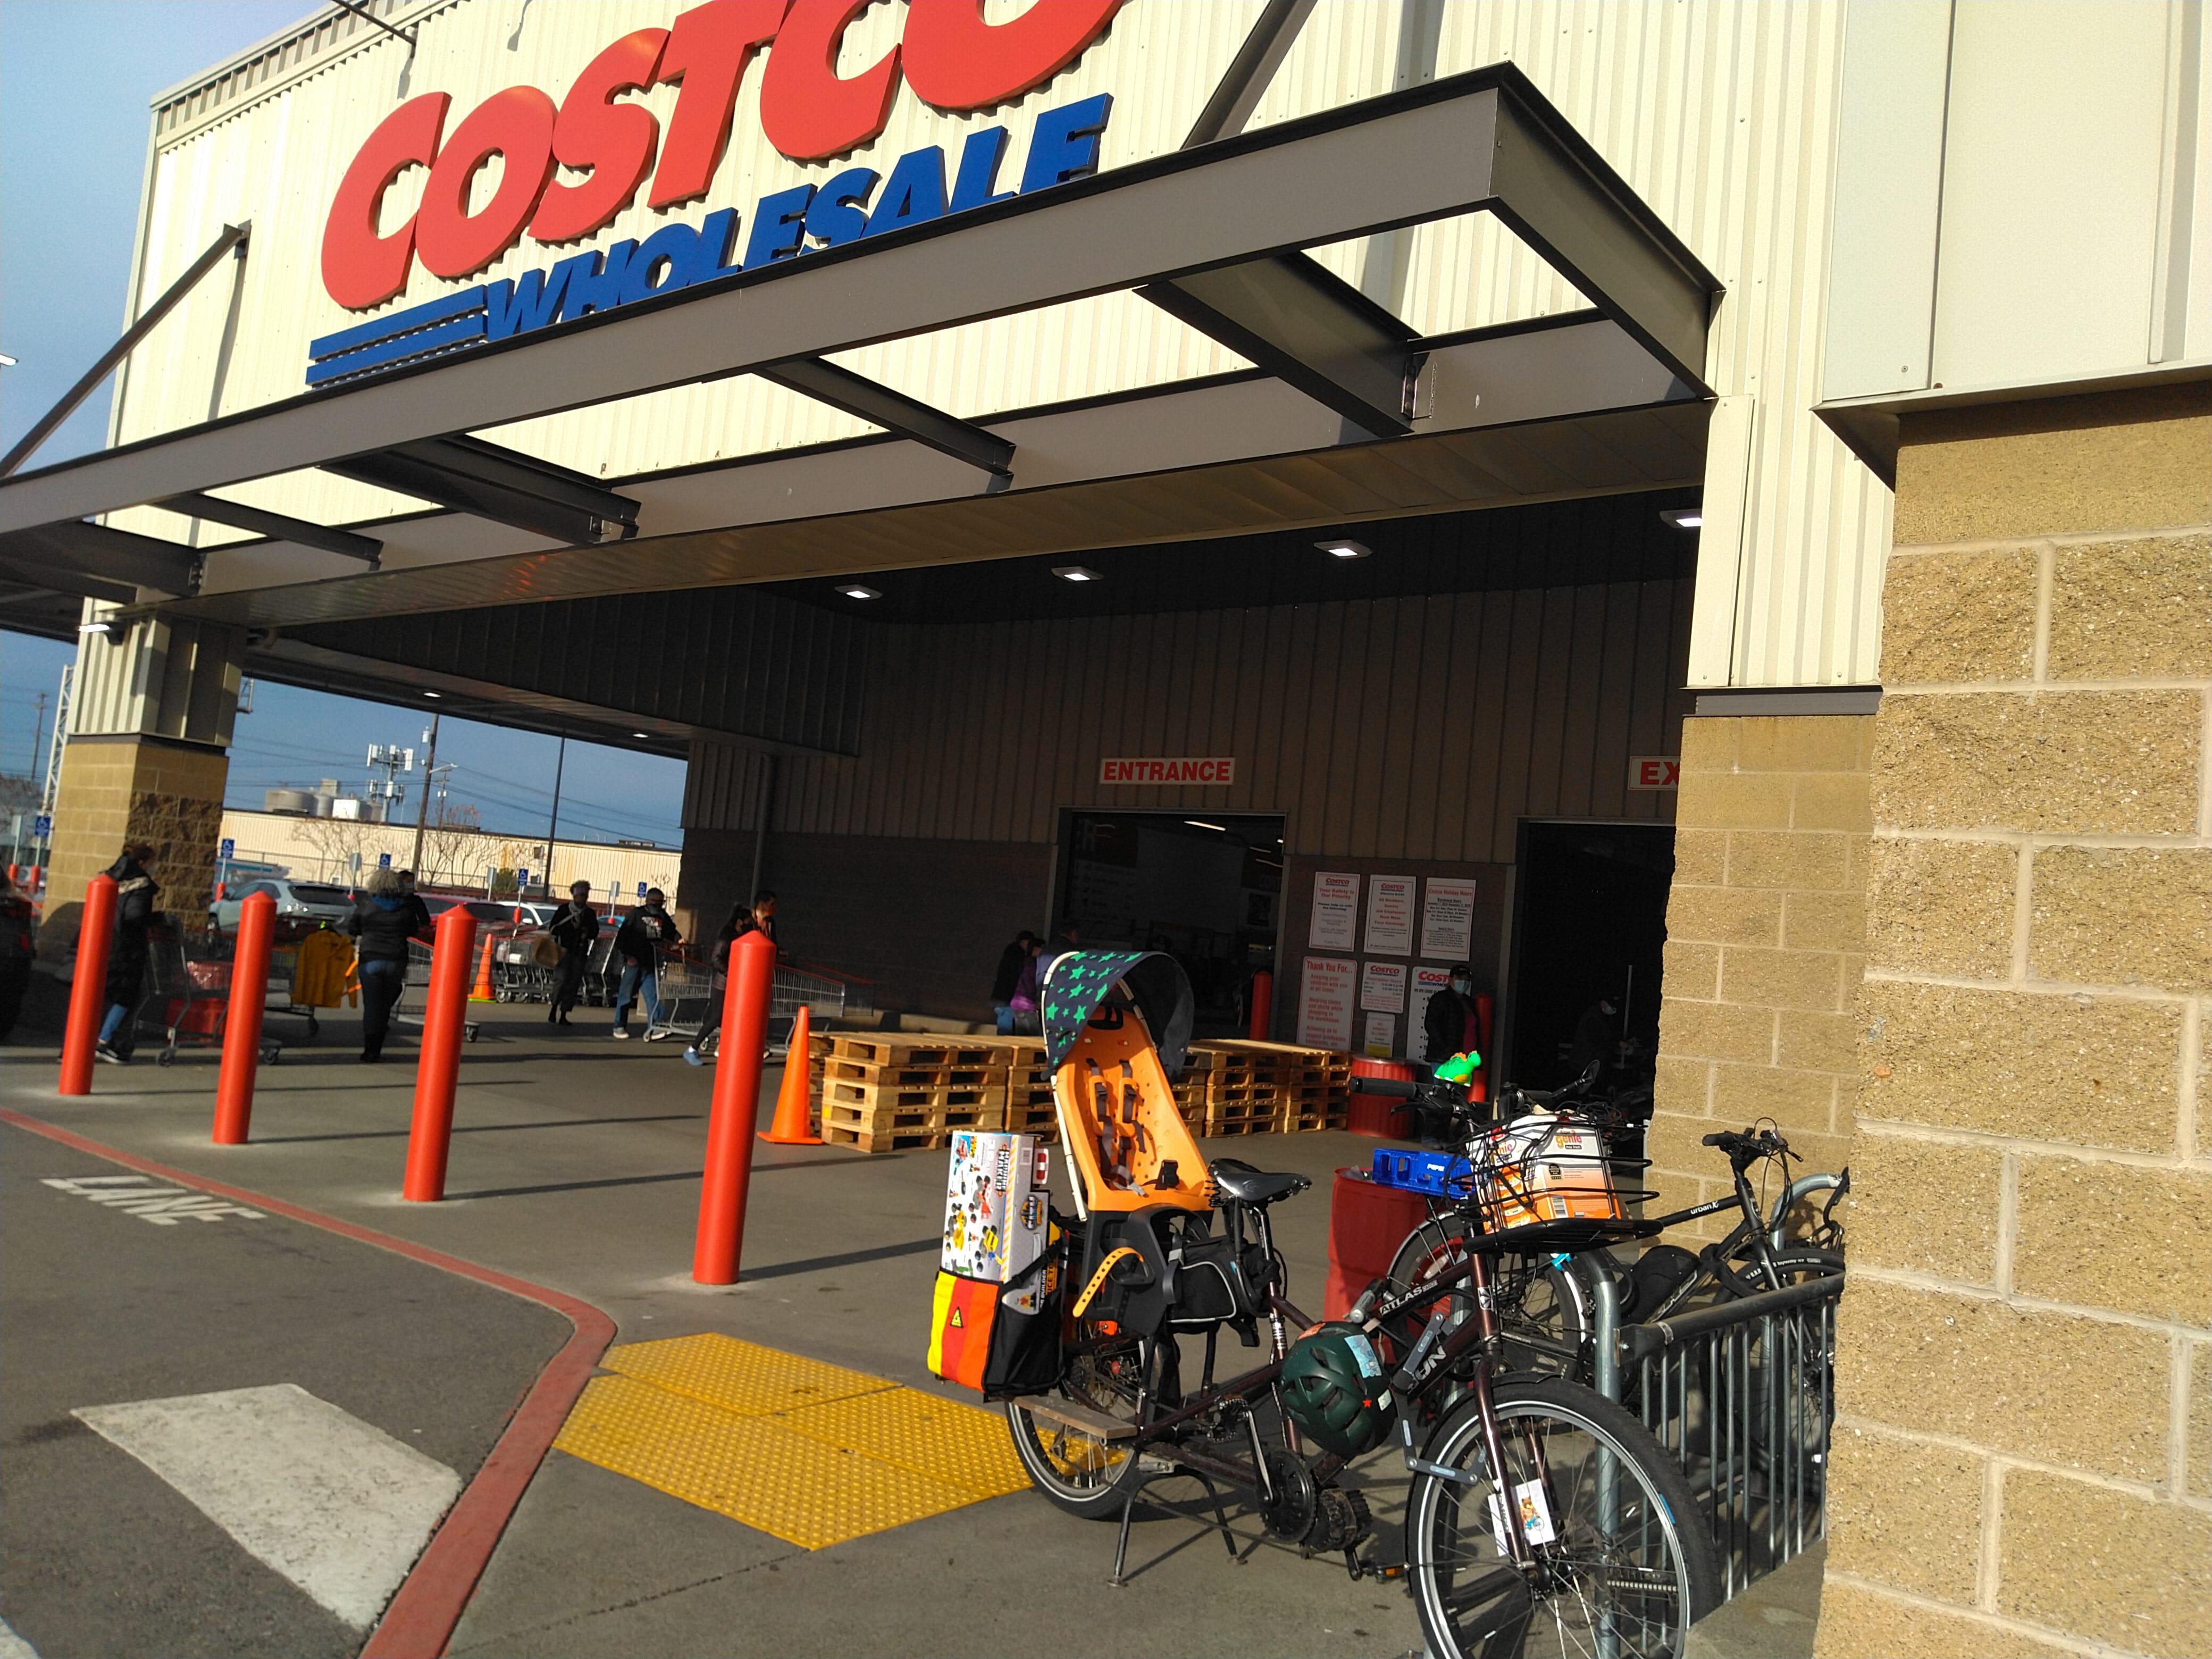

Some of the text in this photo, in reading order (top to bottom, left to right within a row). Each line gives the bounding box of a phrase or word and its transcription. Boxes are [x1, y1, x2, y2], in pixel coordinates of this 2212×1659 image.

[485, 93, 1112, 339] WHOLESALE
[1104, 761, 1231, 781] ENTRANCE
[1640, 761, 1680, 785] EX
[1306, 960, 1323, 970] Thank
[1326, 962, 1336, 971] You
[1418, 971, 1449, 983] COST
[1555, 1129, 1582, 1149] genie
[40, 1175, 267, 1225] LANE
[1379, 1286, 1423, 1315] ATLAS
[1496, 1494, 1510, 1533] CARGO
